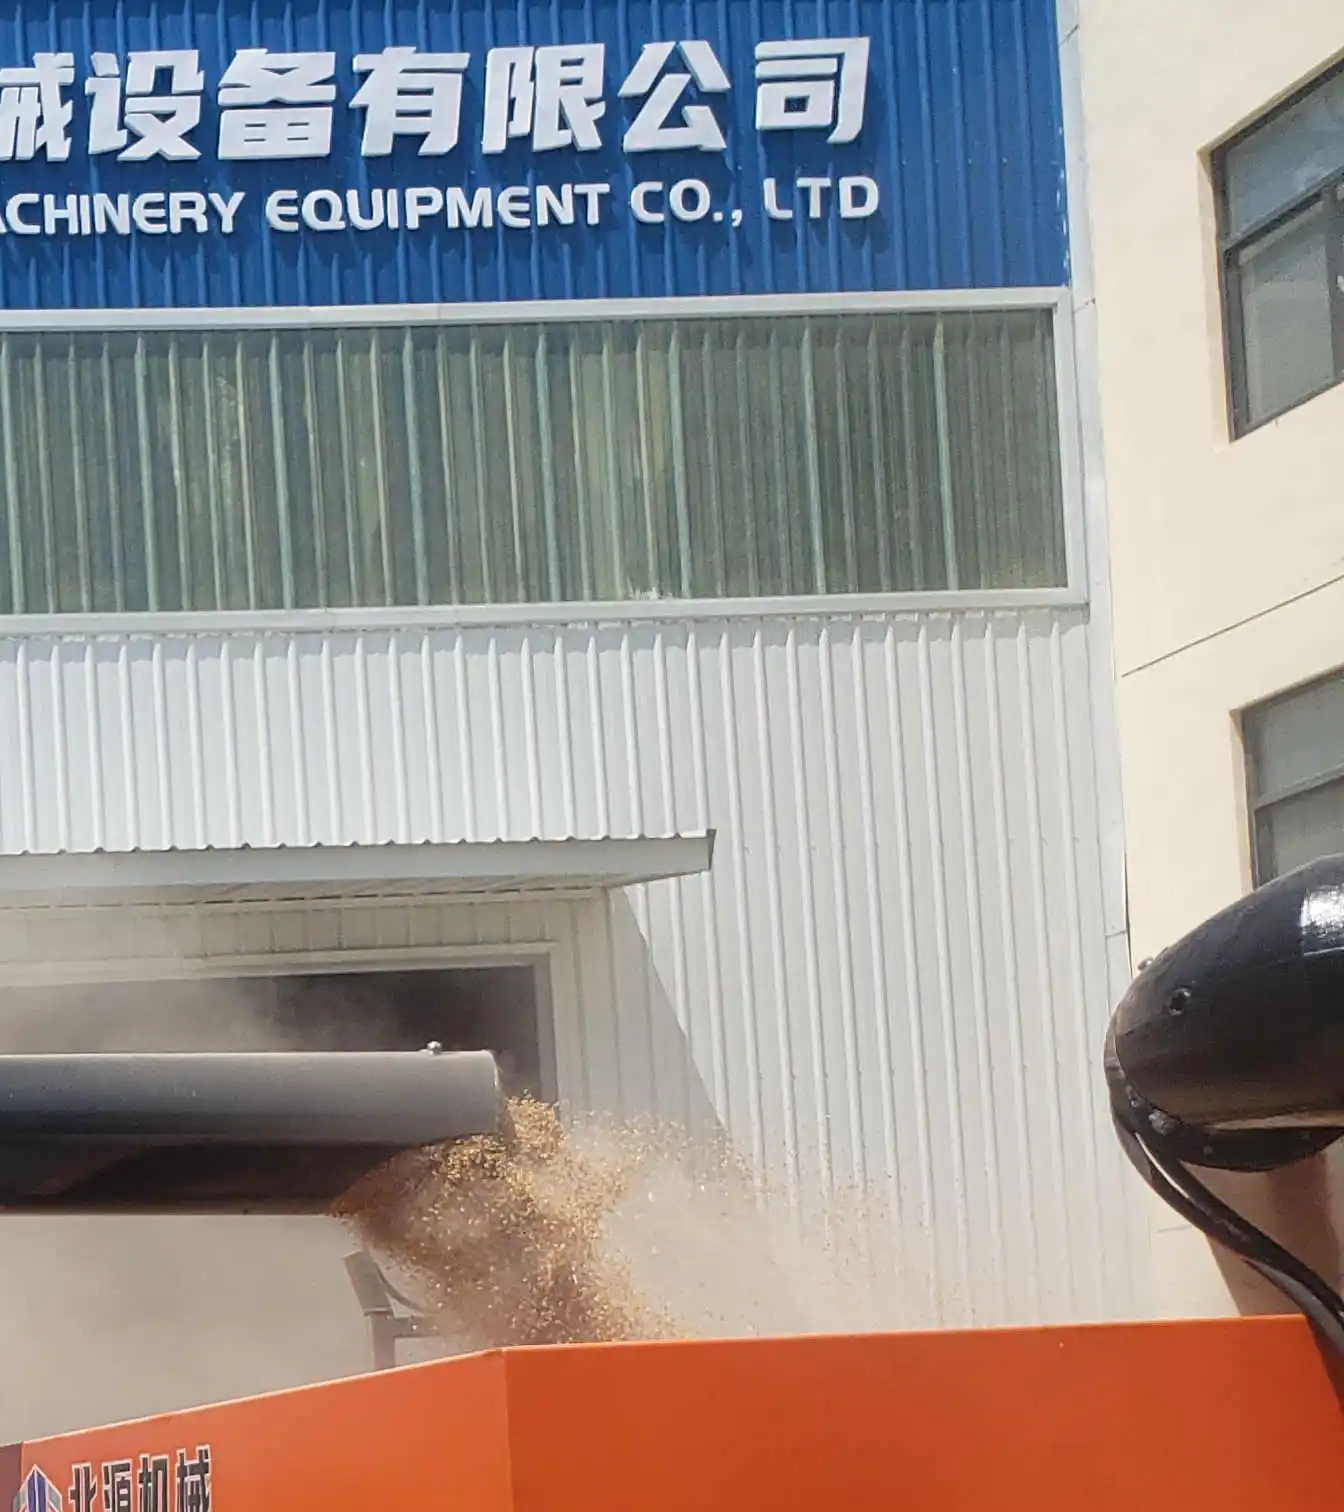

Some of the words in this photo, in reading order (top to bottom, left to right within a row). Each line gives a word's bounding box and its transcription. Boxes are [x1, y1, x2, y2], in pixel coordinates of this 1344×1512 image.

[265, 182, 610, 234] EQUIPMENT
[629, 177, 743, 229] CO.,
[764, 175, 880, 221] LTD
